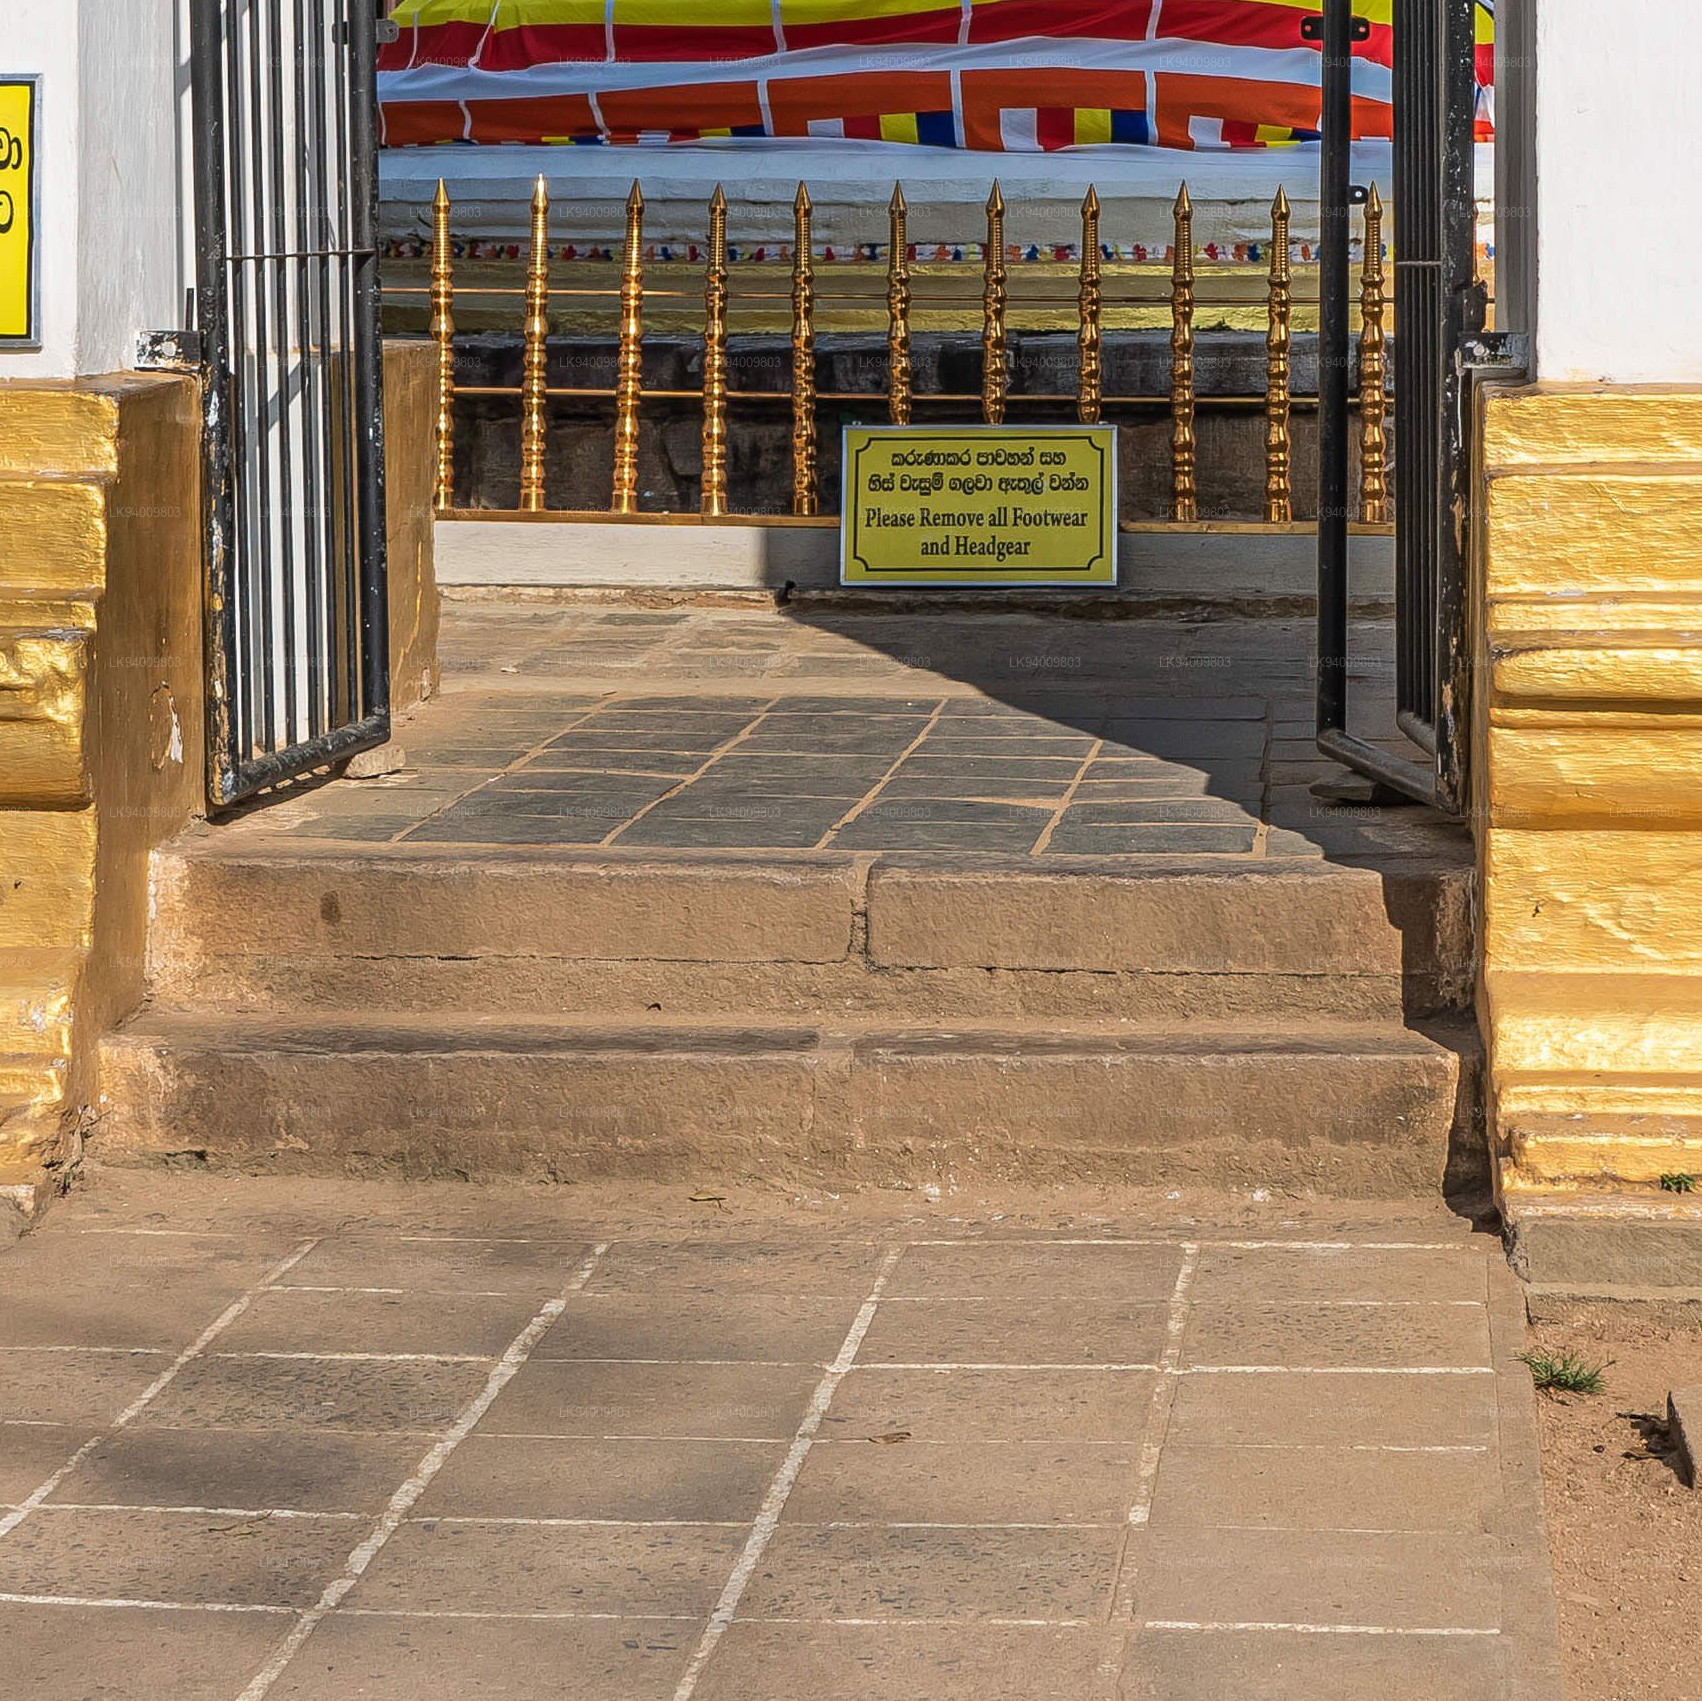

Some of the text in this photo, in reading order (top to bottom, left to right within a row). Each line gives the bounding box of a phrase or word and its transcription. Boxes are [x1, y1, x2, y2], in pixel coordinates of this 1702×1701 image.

[865, 507, 1088, 527] Please Remove all Footwear
[921, 535, 1031, 562] and Headgear
